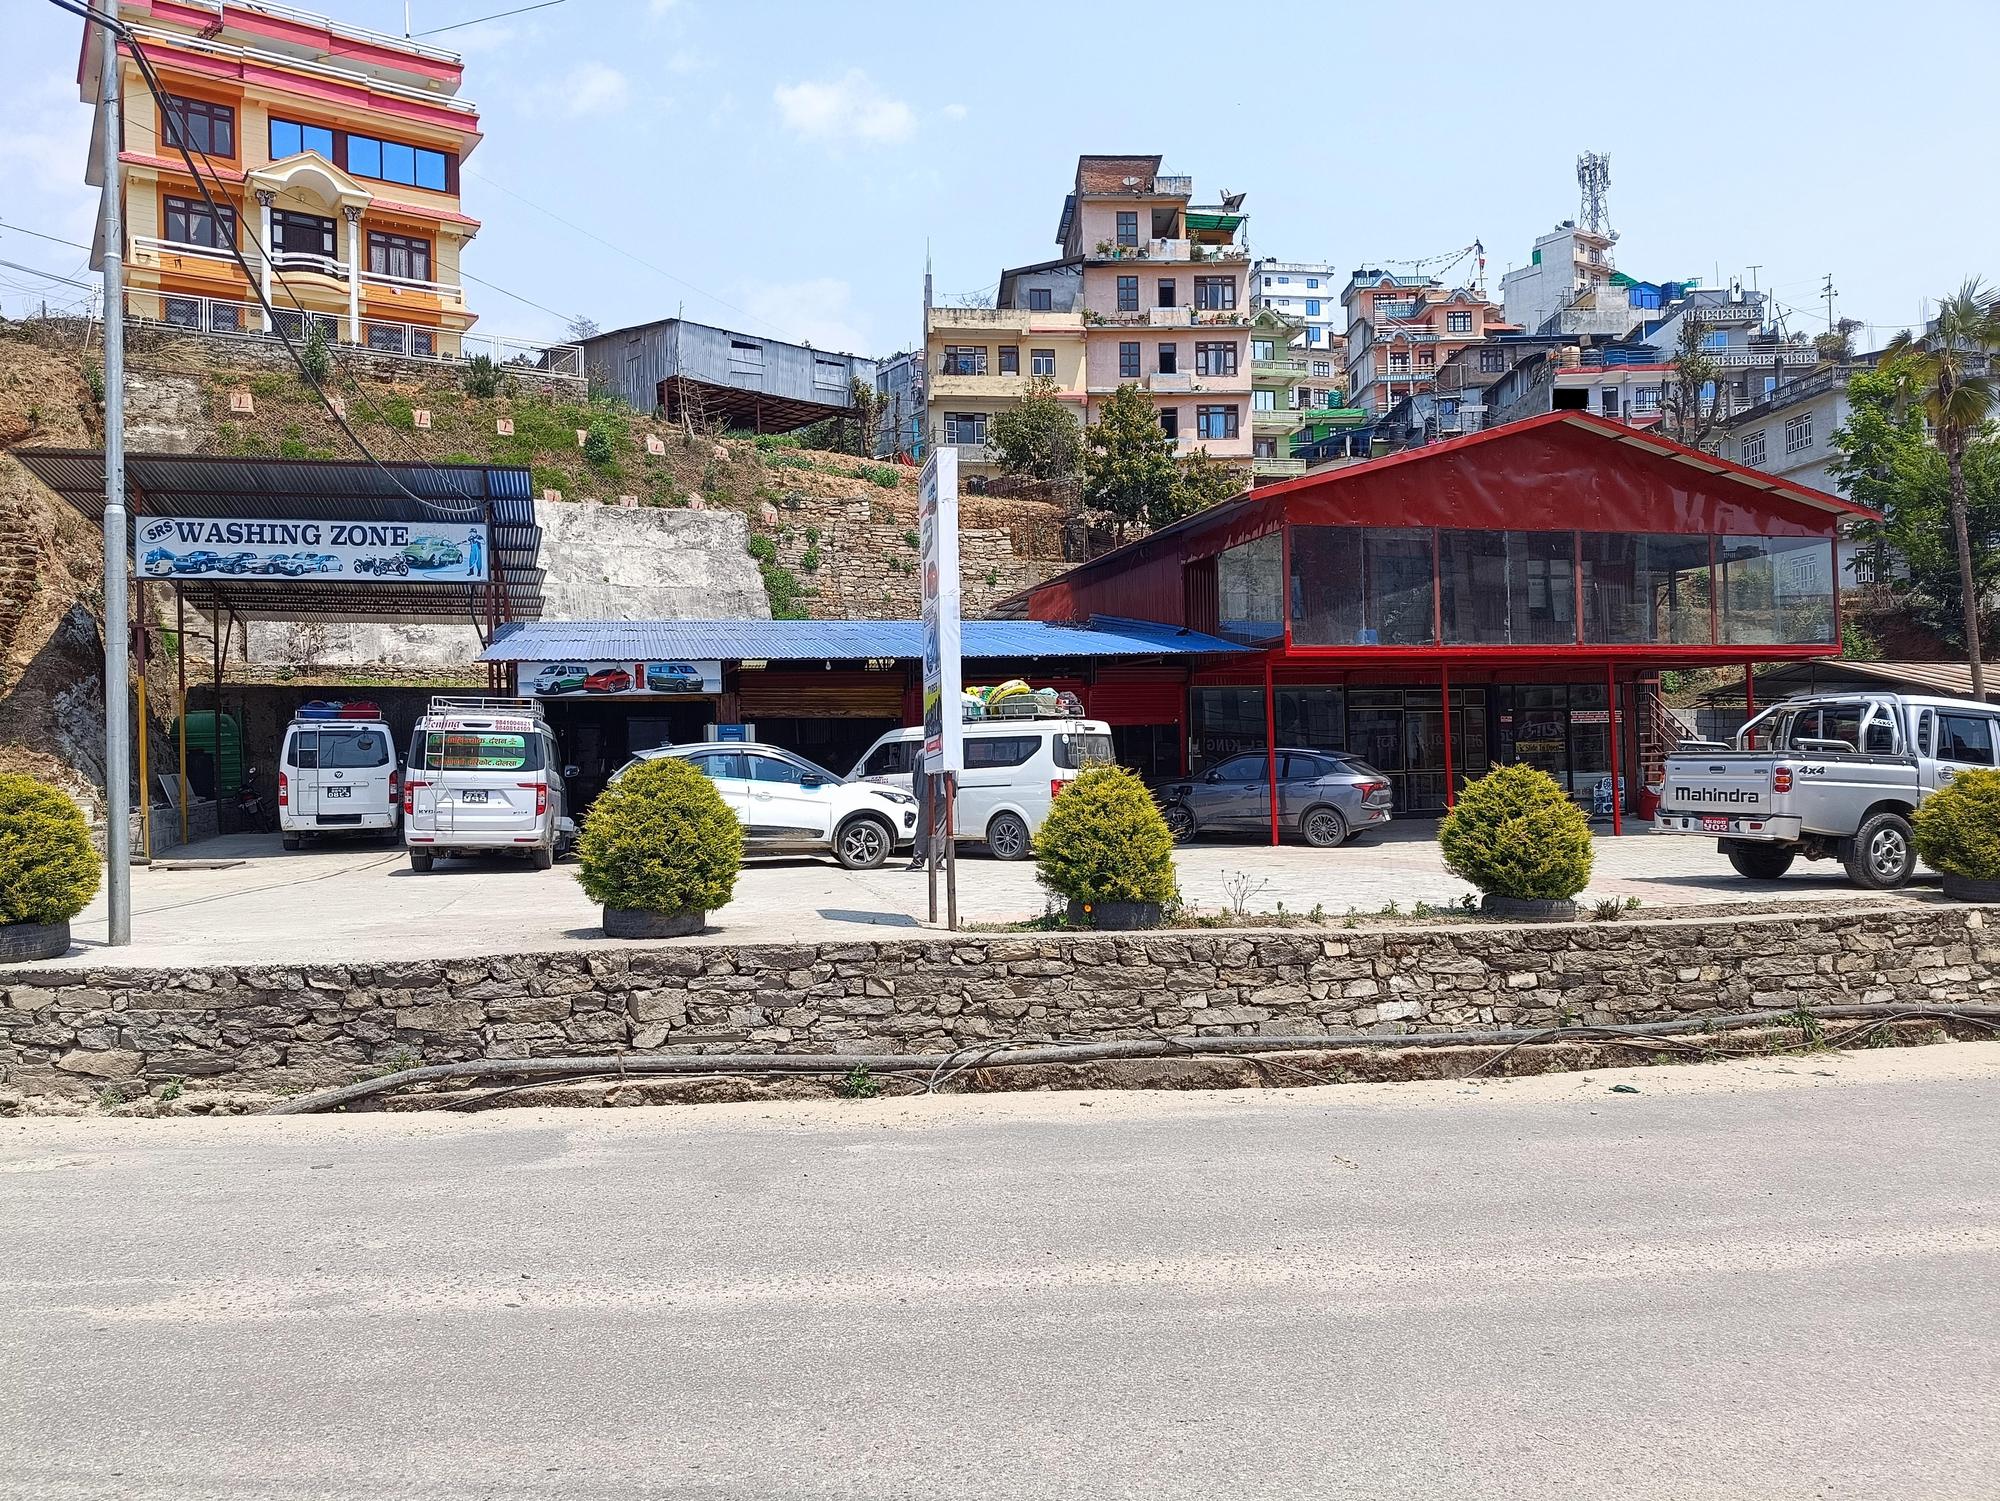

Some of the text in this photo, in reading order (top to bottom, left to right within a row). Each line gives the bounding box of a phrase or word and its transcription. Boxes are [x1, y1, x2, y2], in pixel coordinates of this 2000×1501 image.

[147, 520, 173, 540] SRS
[175, 521, 409, 547] WASHING ZONE
[1675, 786, 1760, 804] Mahindra
